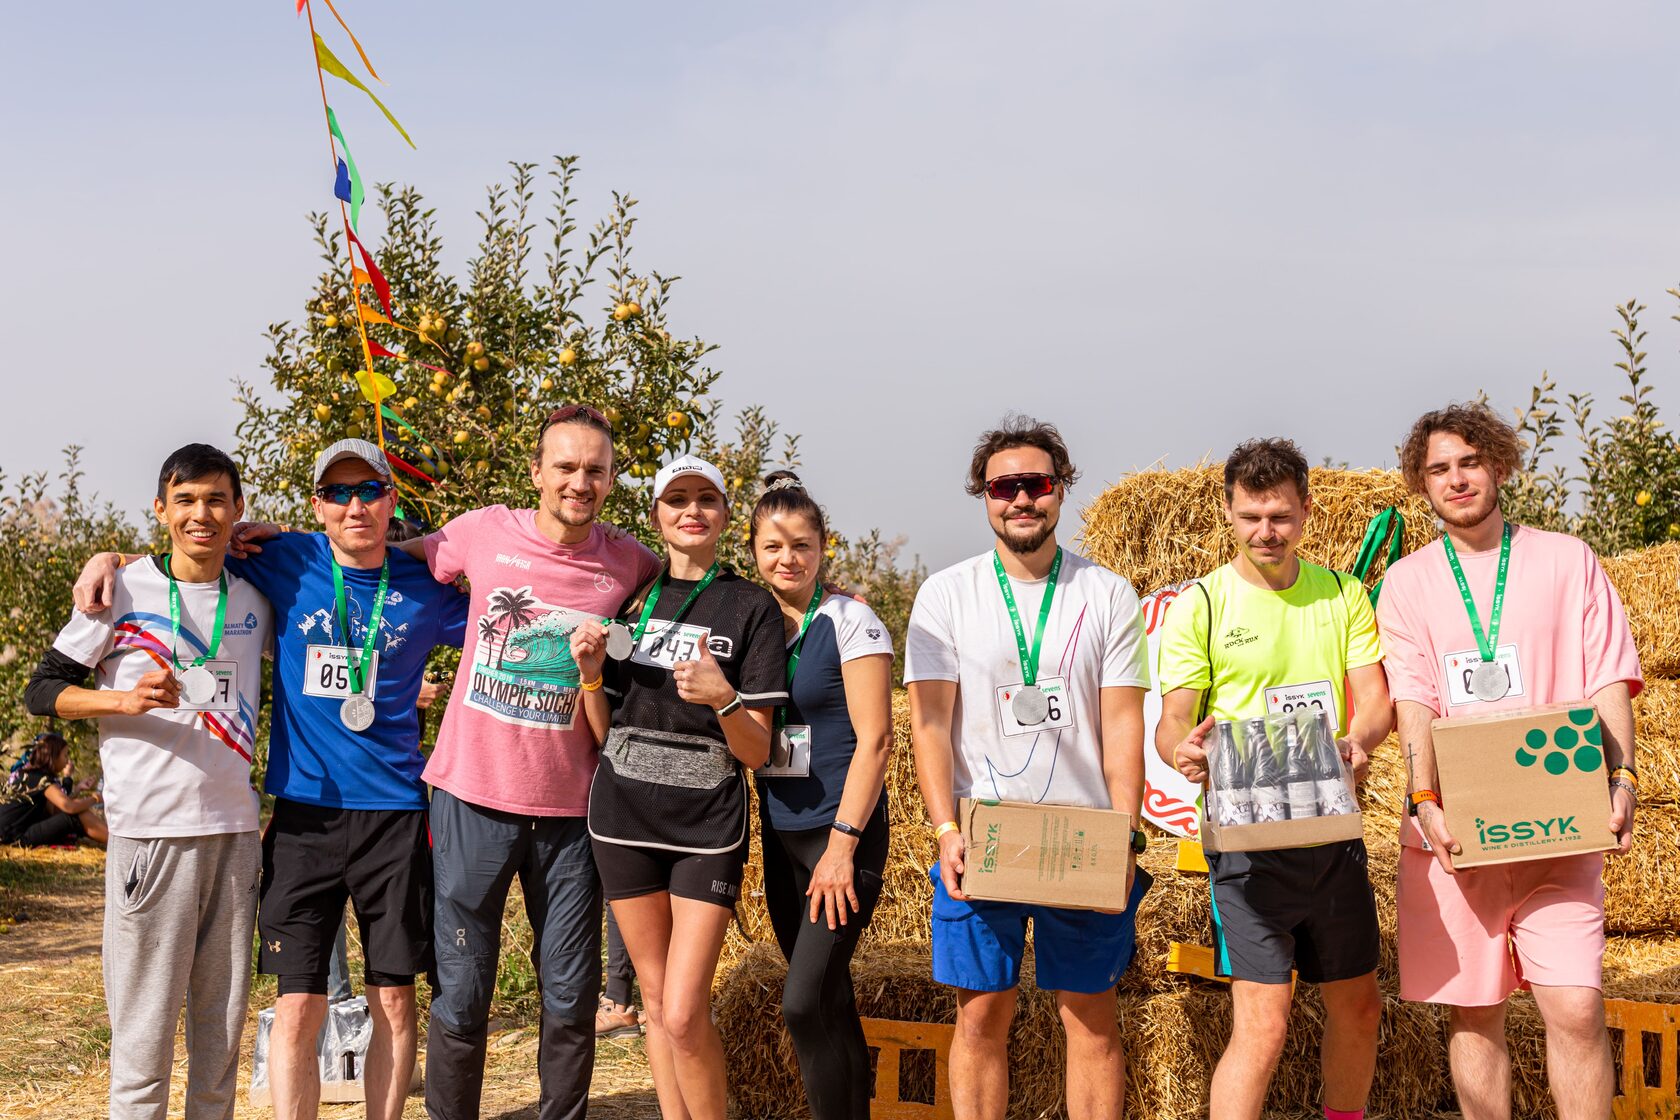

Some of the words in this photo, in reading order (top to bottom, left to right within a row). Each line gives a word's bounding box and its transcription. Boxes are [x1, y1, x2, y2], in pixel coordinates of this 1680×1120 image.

[473, 672, 534, 709] OLYMPIC
[473, 692, 517, 716] CHALLENGE
[519, 709, 541, 721] YOUR
[711, 880, 728, 894] RISE
